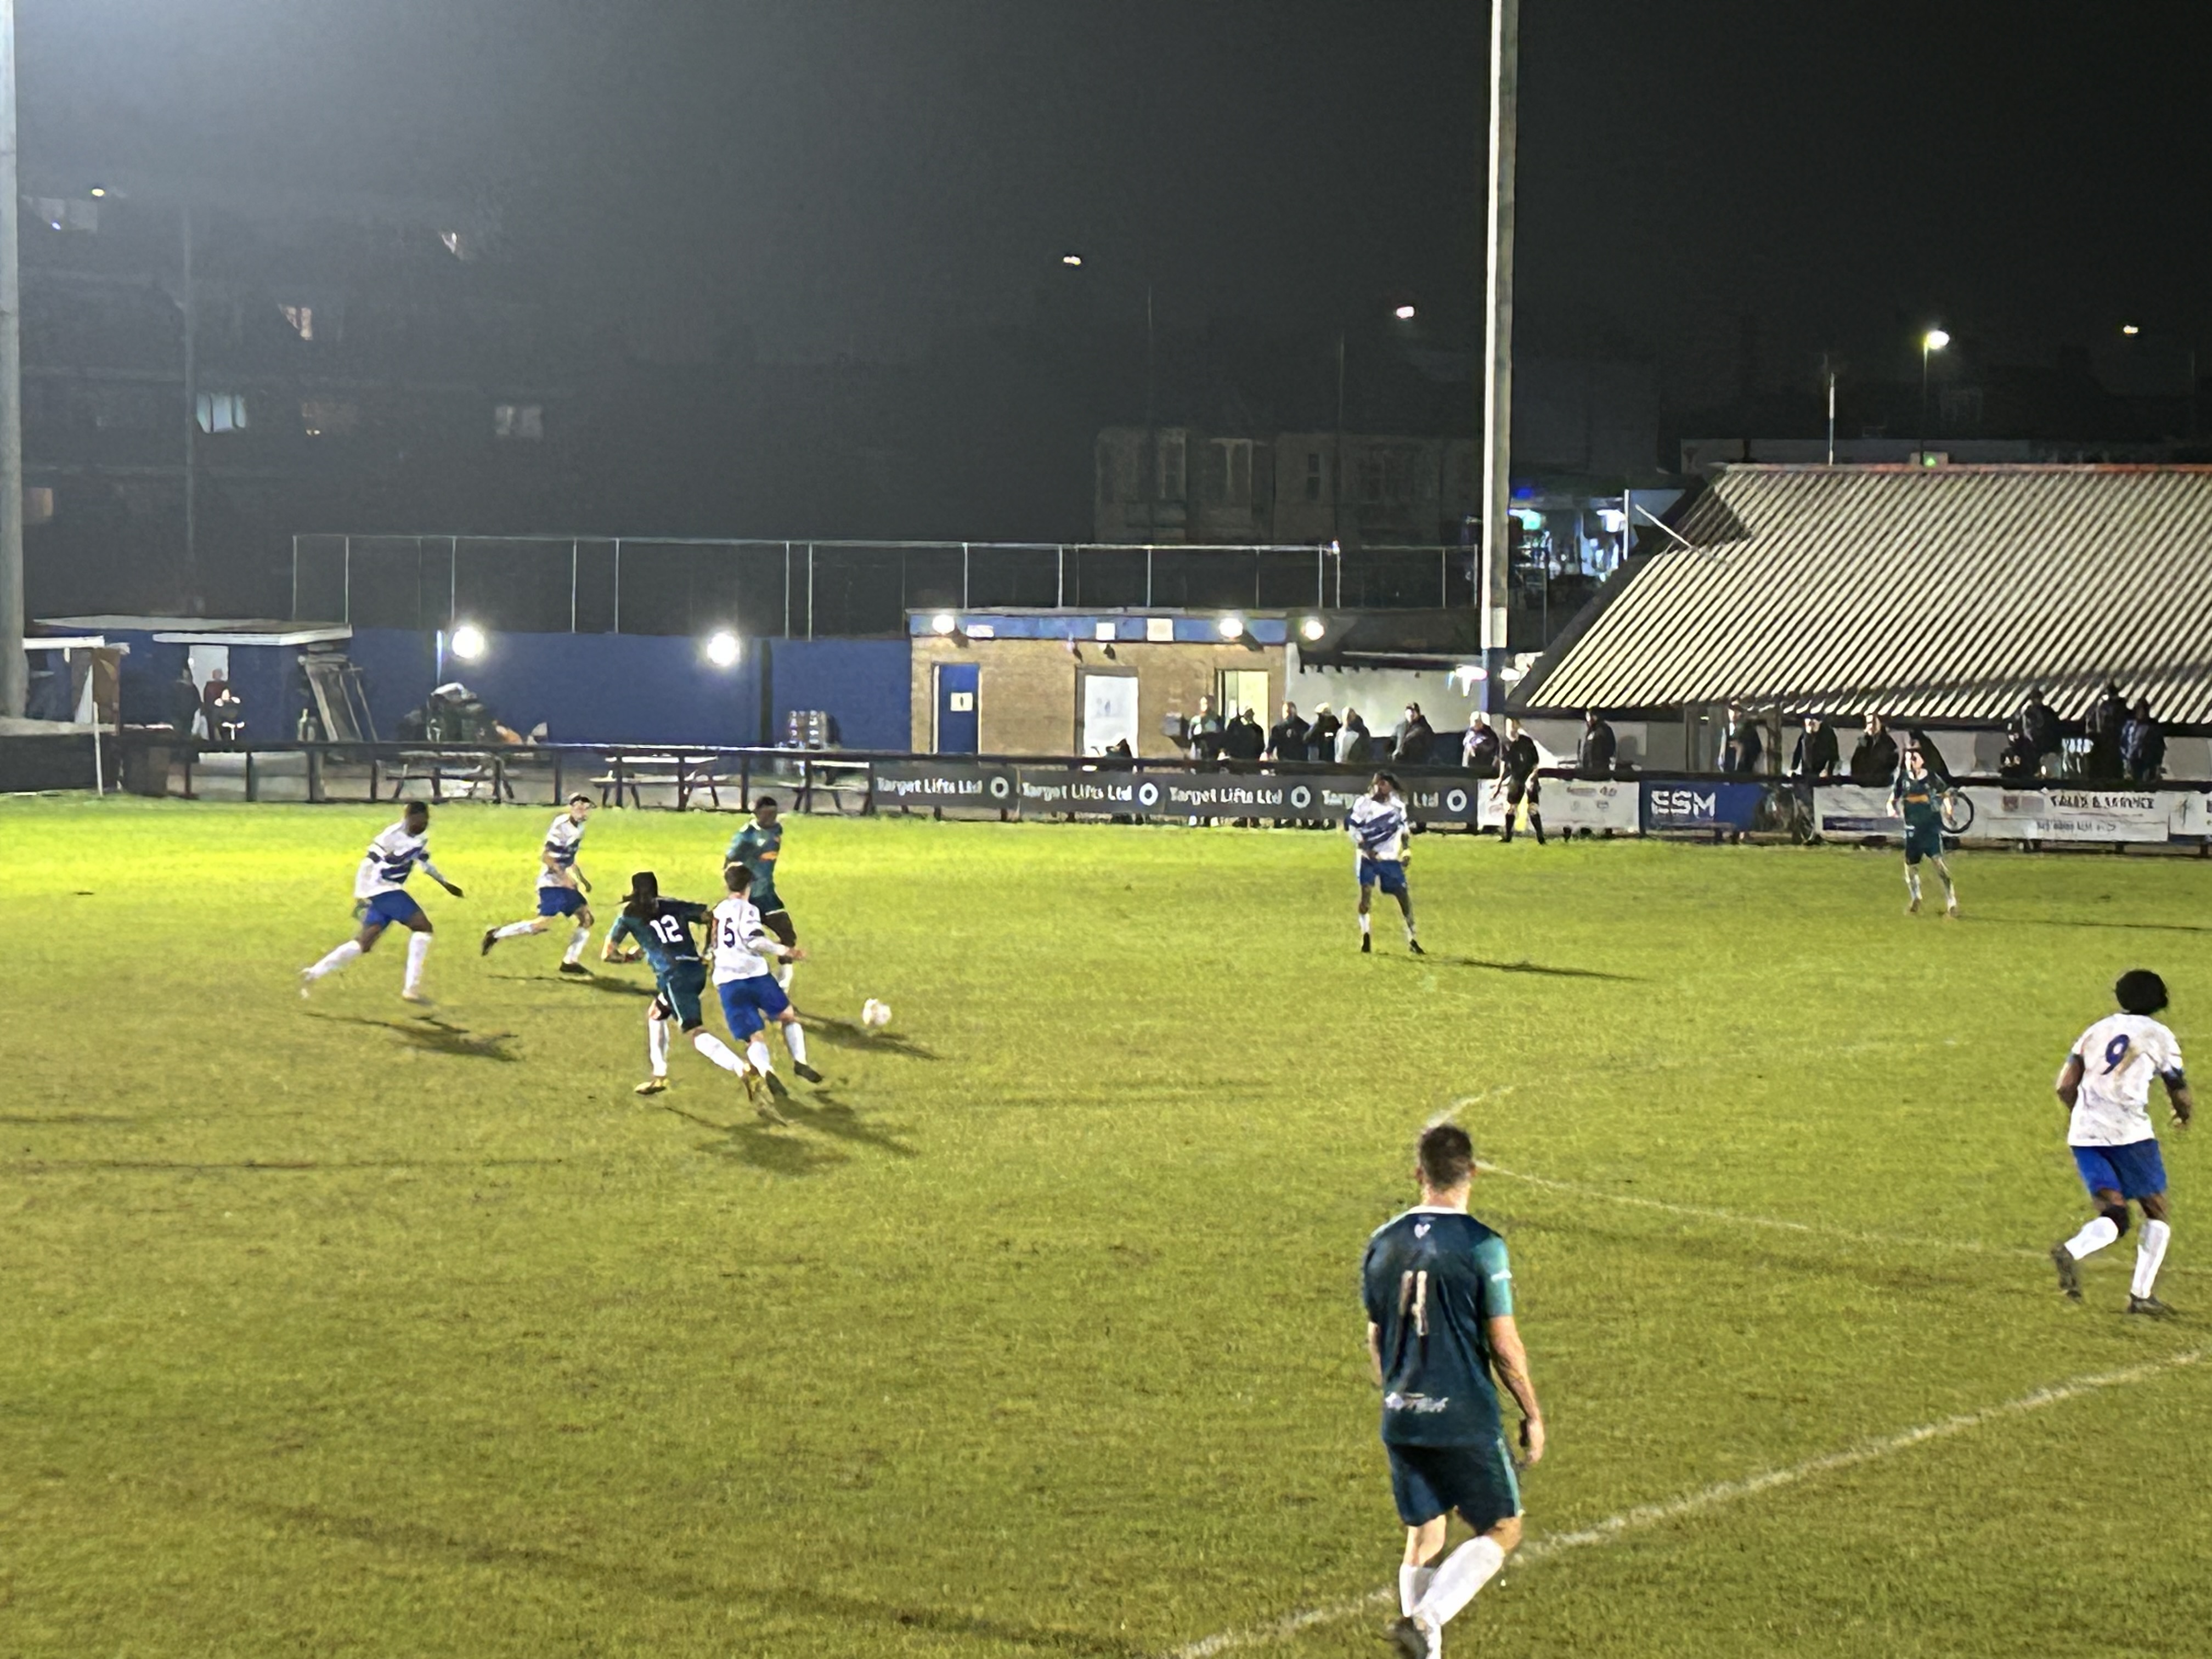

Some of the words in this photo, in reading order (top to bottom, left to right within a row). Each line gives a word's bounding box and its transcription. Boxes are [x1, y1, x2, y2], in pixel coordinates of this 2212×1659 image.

[876, 777, 921, 796] Target
[924, 778, 955, 794] Lifts
[1108, 783, 1132, 800] Ltd
[1257, 789, 1283, 805] Ltd
[1651, 790, 1716, 817] ESM
[649, 914, 684, 944] 12
[2101, 1034, 2130, 1075] 9
